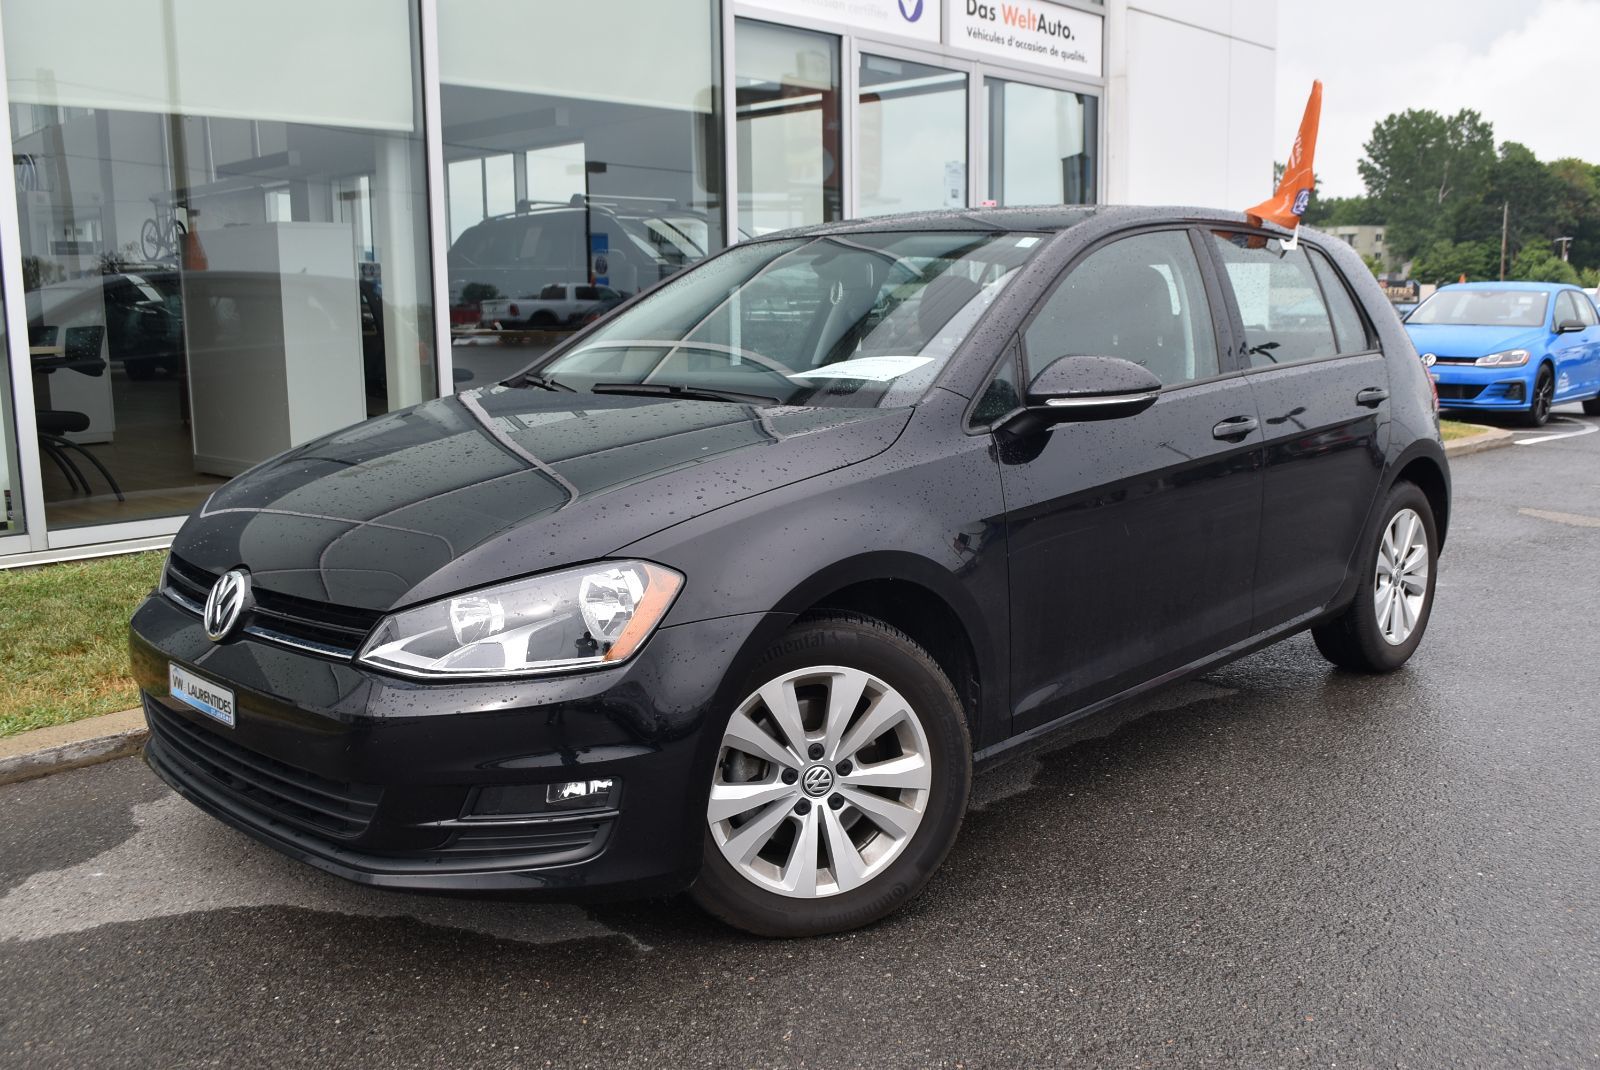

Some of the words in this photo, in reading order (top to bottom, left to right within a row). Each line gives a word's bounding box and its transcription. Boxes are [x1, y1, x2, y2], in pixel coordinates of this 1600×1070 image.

[966, 0, 996, 21] Das
[1001, 3, 1075, 41] WeltAuto.
[966, 26, 1005, 45] Véhicules
[1050, 45, 1059, 57] de
[188, 682, 231, 715] LAURENTIDES
